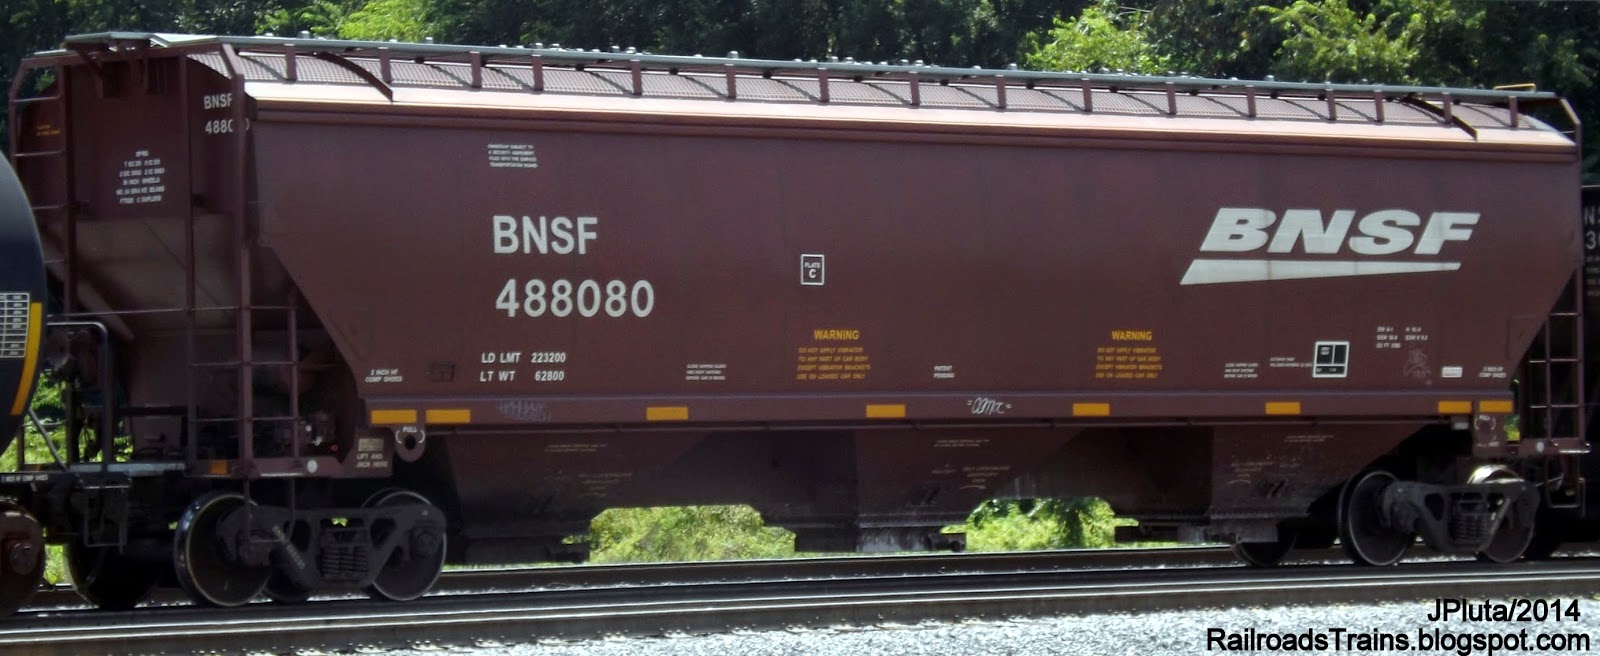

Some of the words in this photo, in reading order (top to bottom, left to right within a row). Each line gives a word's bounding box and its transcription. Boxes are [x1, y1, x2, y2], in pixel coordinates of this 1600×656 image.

[203, 93, 232, 110] BNSF
[493, 215, 598, 254] BNSF
[1199, 207, 1481, 255] BNSF
[808, 268, 817, 279] C
[495, 278, 655, 318] 488080
[814, 329, 860, 341] WARNING
[1111, 330, 1153, 341] WARNING
[481, 352, 496, 364] LD
[500, 352, 521, 364] LMT
[530, 352, 567, 363] 223200
[479, 370, 494, 382] LT
[498, 370, 516, 381] WT
[534, 370, 565, 382] 62800
